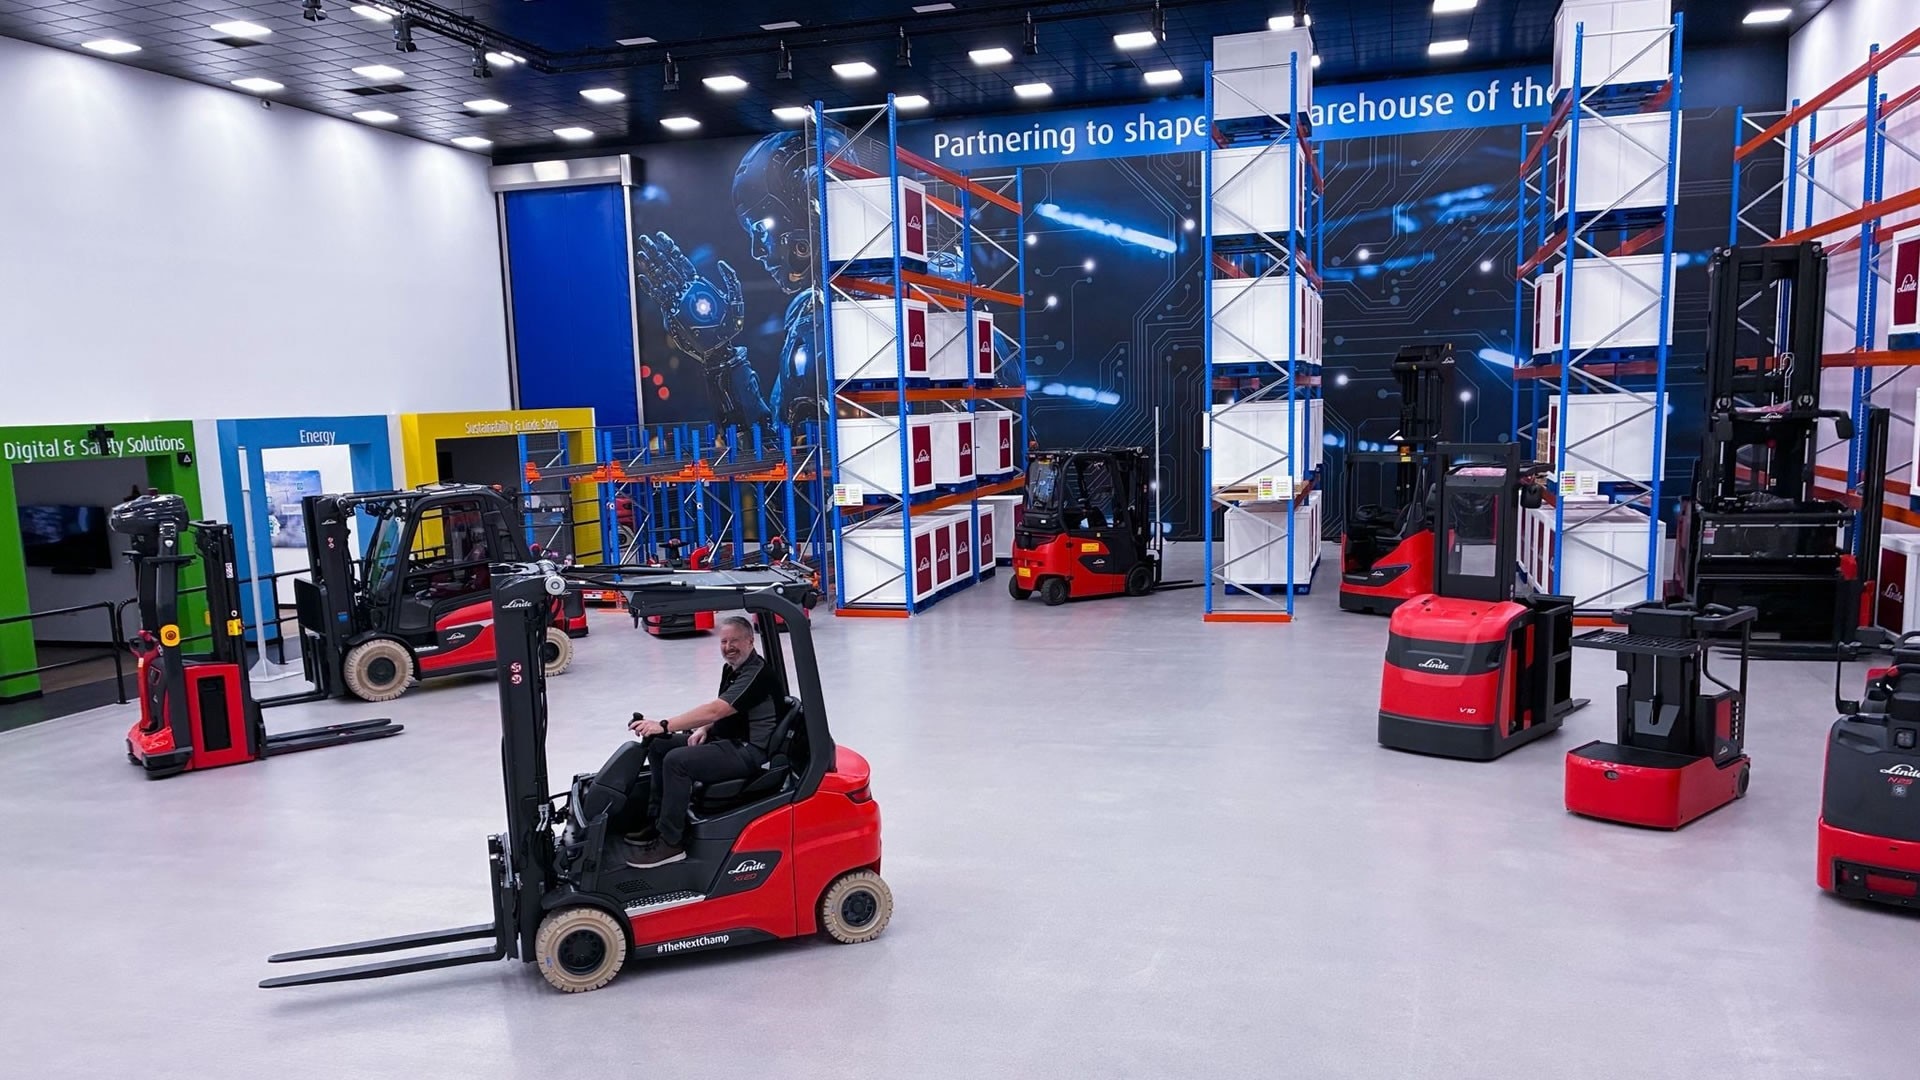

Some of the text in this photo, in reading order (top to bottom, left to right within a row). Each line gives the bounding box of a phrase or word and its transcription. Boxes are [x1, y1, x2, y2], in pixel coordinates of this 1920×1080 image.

[934, 123, 1076, 158] Partnering
[1086, 120, 1114, 145] to
[1124, 113, 1206, 145] shape
[1312, 93, 1454, 126] arehouse
[1467, 80, 1500, 112] of
[465, 419, 513, 435] Sustainability
[515, 420, 521, 430] &
[300, 429, 336, 446] Energy
[3, 438, 59, 463] Digital
[64, 439, 75, 456] &
[128, 435, 185, 454] Solutions
[502, 598, 532, 608] Linde
[1418, 658, 1449, 670] Linde
[728, 859, 766, 874] Linde
[657, 934, 729, 953] #TheNextChamp
